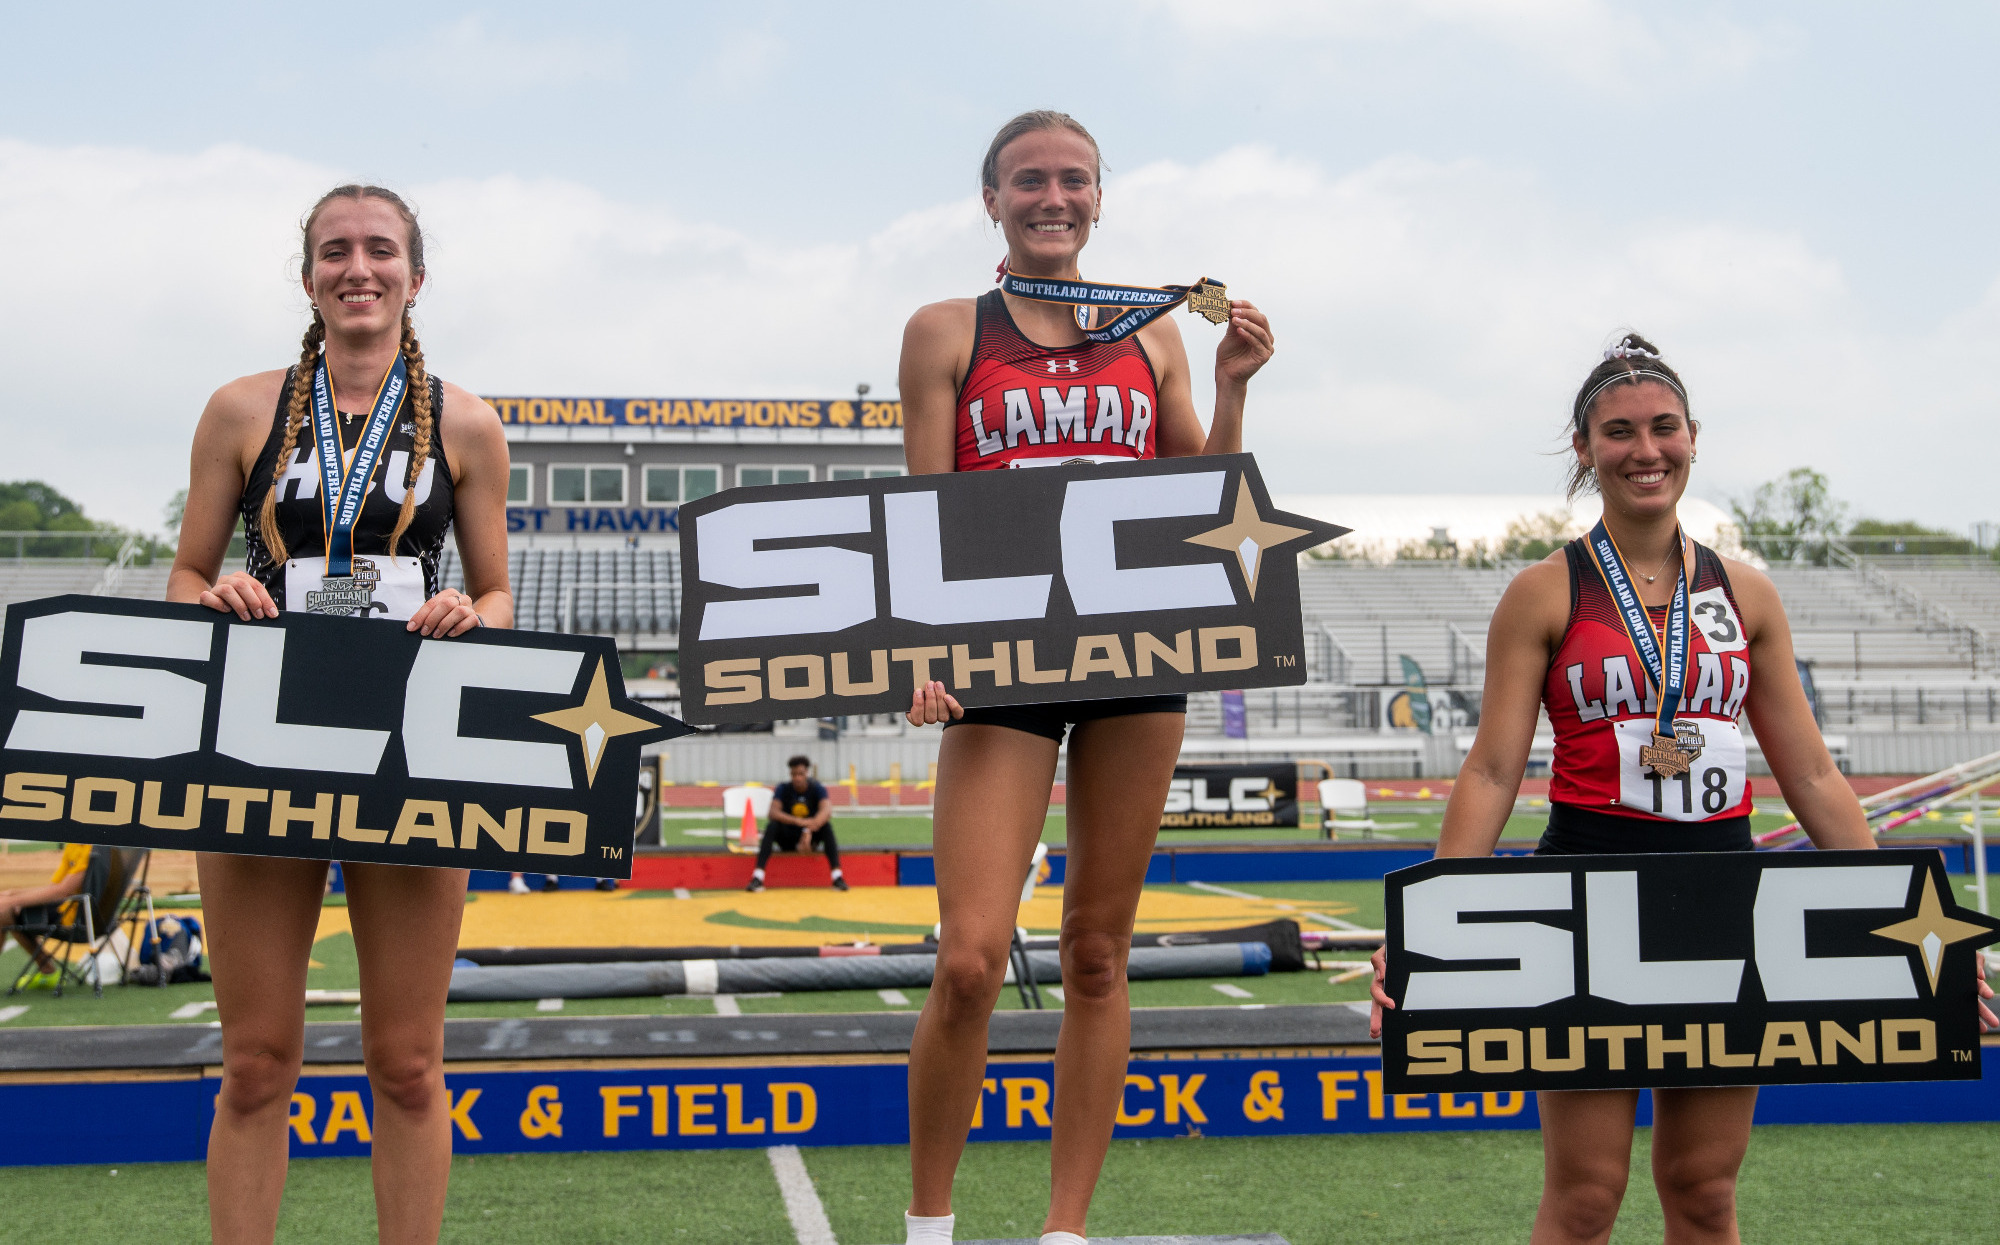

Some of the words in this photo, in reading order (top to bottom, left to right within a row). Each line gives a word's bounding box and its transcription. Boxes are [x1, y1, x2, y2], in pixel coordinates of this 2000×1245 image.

[1011, 280, 1088, 299] SOUTHLAND
[1090, 288, 1174, 303] CONFERENCE
[315, 366, 333, 437] SOUTHLAND
[625, 399, 821, 428] CHAMPIONS
[969, 385, 1152, 458] LAMAR
[340, 449, 374, 525] SOUTHLAND
[366, 375, 402, 450] CONFERENCE
[566, 508, 679, 532] HAWK
[362, 572, 378, 580] FIELD
[695, 470, 1237, 641] SLC
[1597, 539, 1635, 608] SOUTHLAND
[307, 590, 370, 608] SOUTHLAND
[1694, 601, 1737, 643] 3
[704, 625, 1258, 706] SOUTHLAND
[1274, 655, 1296, 668] TM
[1669, 611, 1684, 688] SOUTHLAND
[4, 610, 586, 789] SLC
[1642, 747, 1689, 769] SOUTHLAND
[0, 771, 589, 857] SOUTHLAND
[1163, 777, 1270, 812] SLC
[1644, 766, 1728, 814] 118
[601, 847, 623, 860] TM
[1402, 865, 1918, 1011] SLC
[1406, 1018, 1937, 1076] SOUTHLAND
[1951, 1050, 1972, 1062] TM
[214, 1089, 482, 1143] RAK
[520, 1085, 563, 1139] &
[600, 1082, 817, 1137] FIELD
[1243, 1070, 1284, 1122] &
